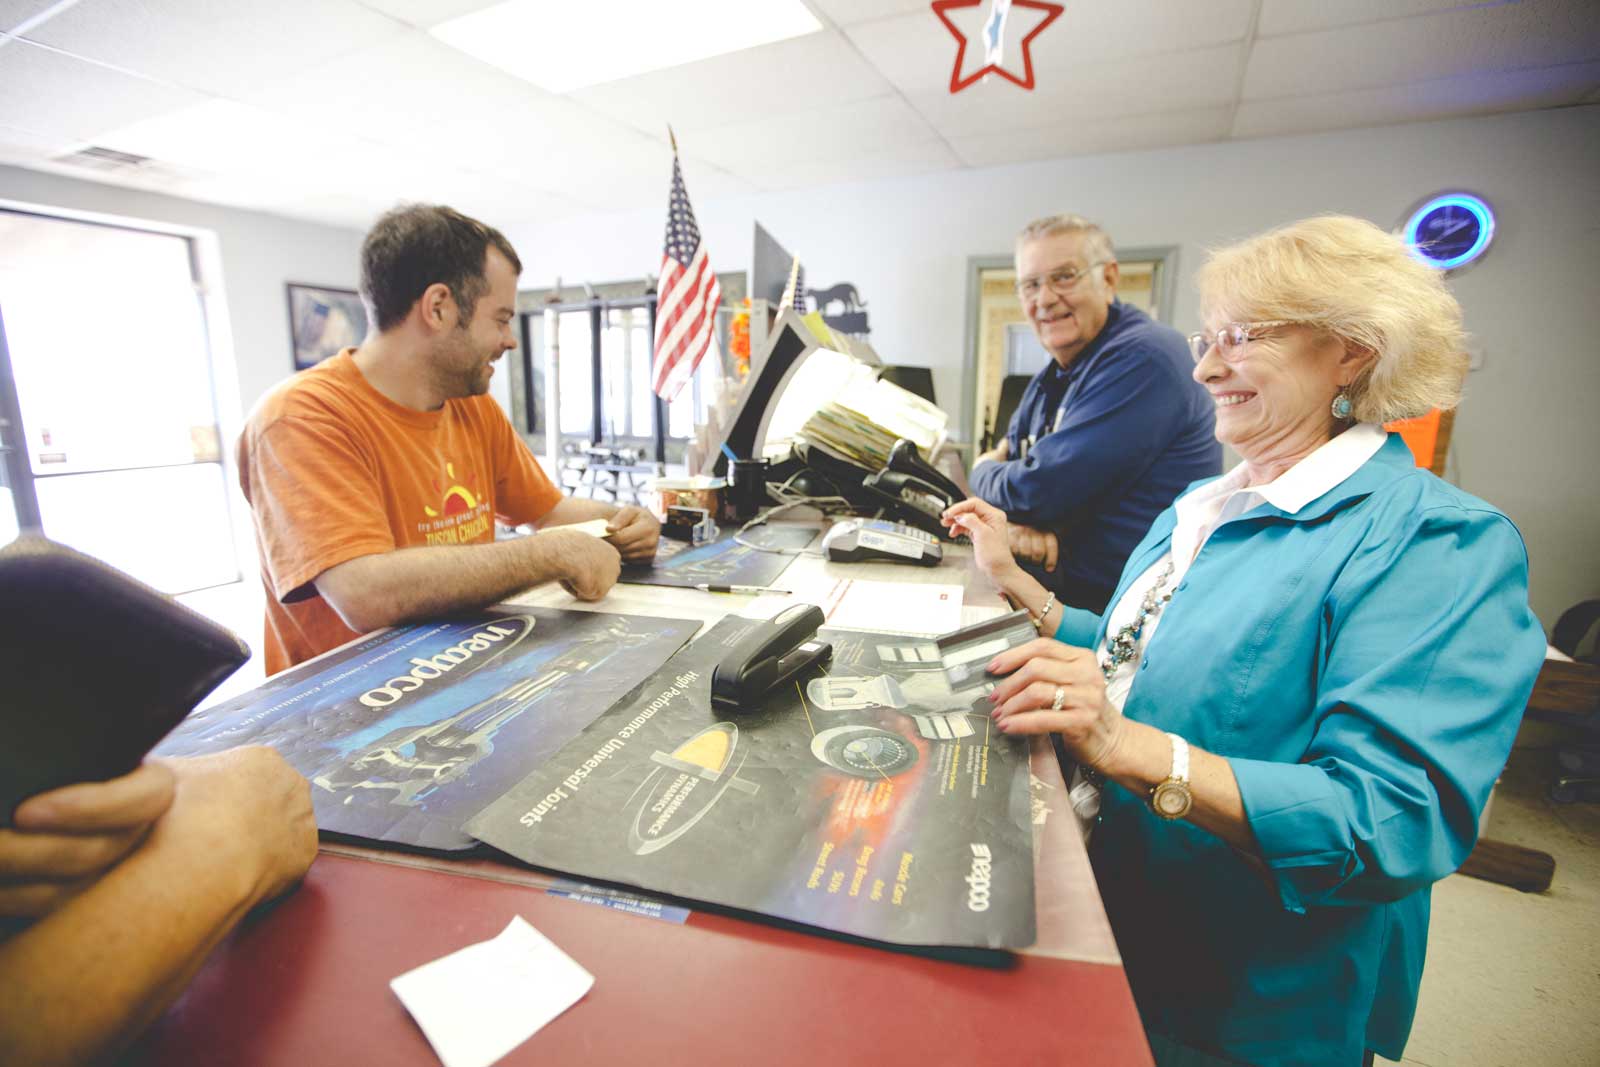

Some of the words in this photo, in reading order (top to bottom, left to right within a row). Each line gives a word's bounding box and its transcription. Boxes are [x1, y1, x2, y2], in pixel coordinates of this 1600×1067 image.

[359, 625, 516, 707] neapco
[675, 671, 700, 689] High
[618, 687, 681, 739] Performance
[562, 738, 625, 791] Universal
[519, 786, 569, 828] Joints
[648, 776, 700, 835] PERFORMANCE
[651, 773, 689, 813] DYNAMICS
